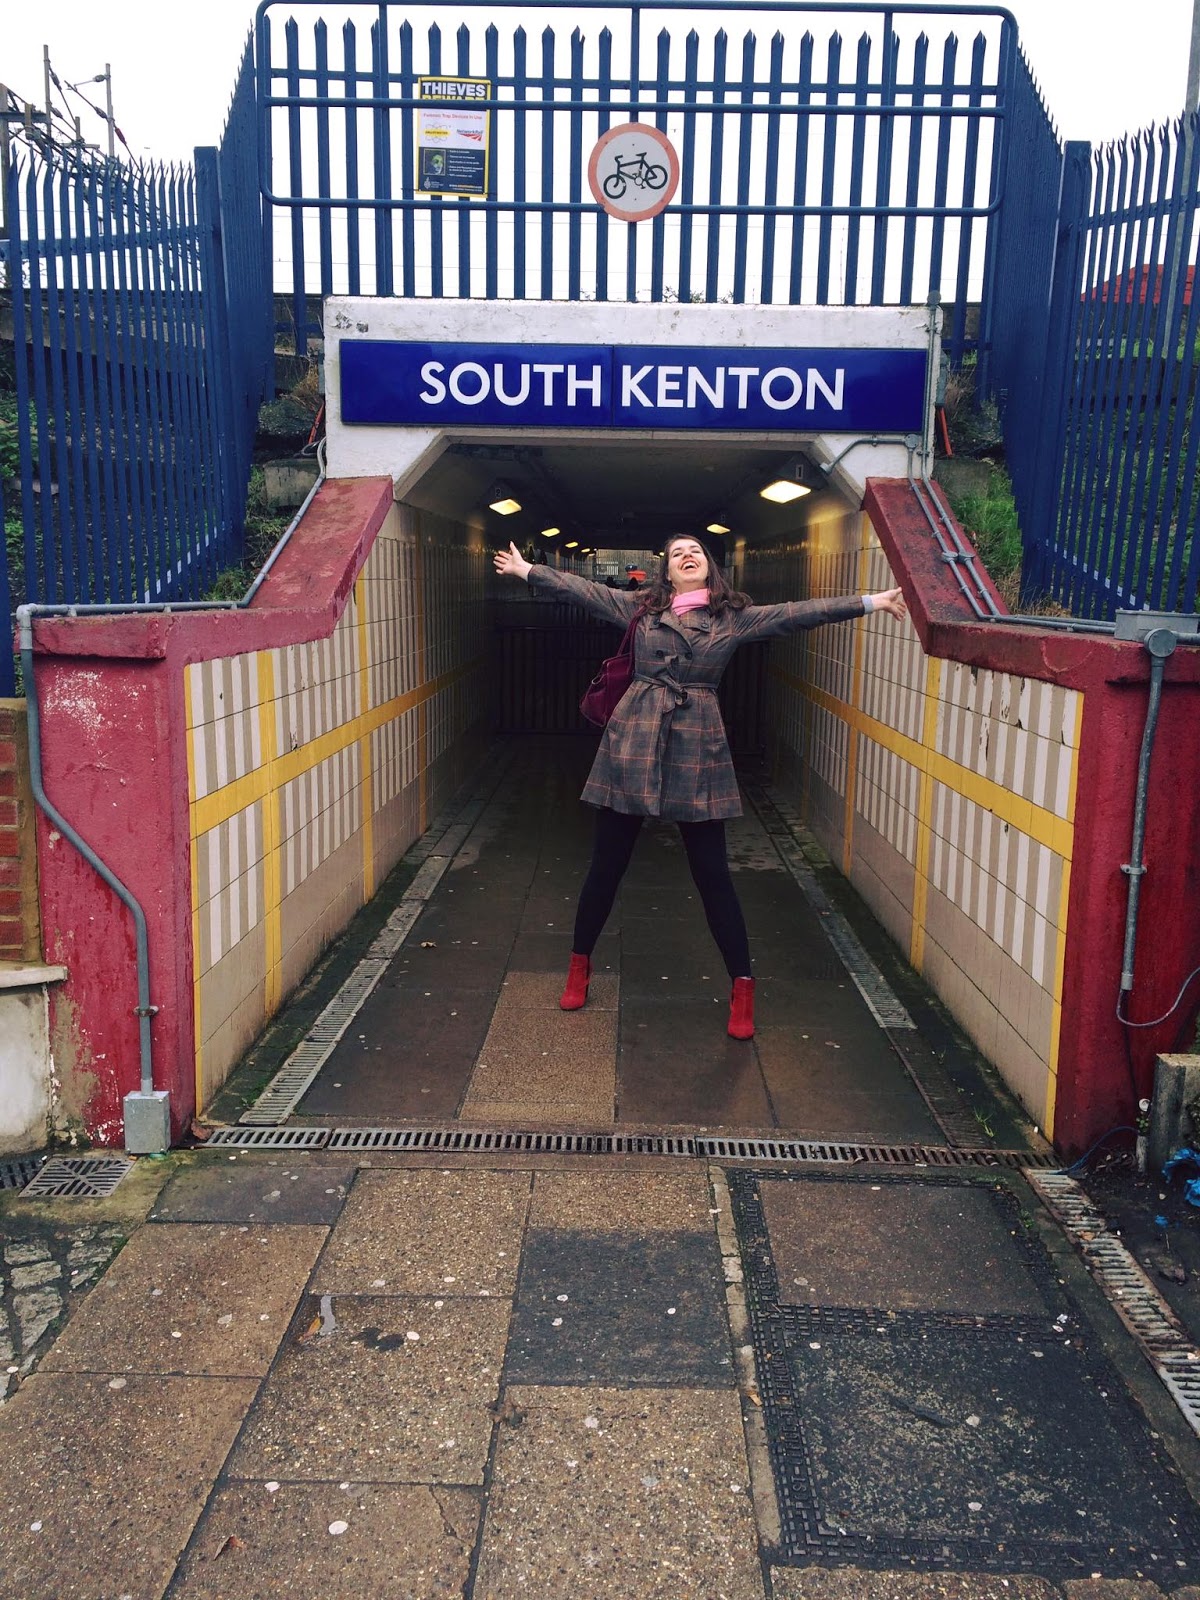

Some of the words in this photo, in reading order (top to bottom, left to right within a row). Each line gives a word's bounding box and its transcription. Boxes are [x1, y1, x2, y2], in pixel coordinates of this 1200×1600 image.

[422, 82, 486, 97] THIEVES
[419, 361, 602, 407] SOUTH
[621, 364, 844, 411] KENTON
